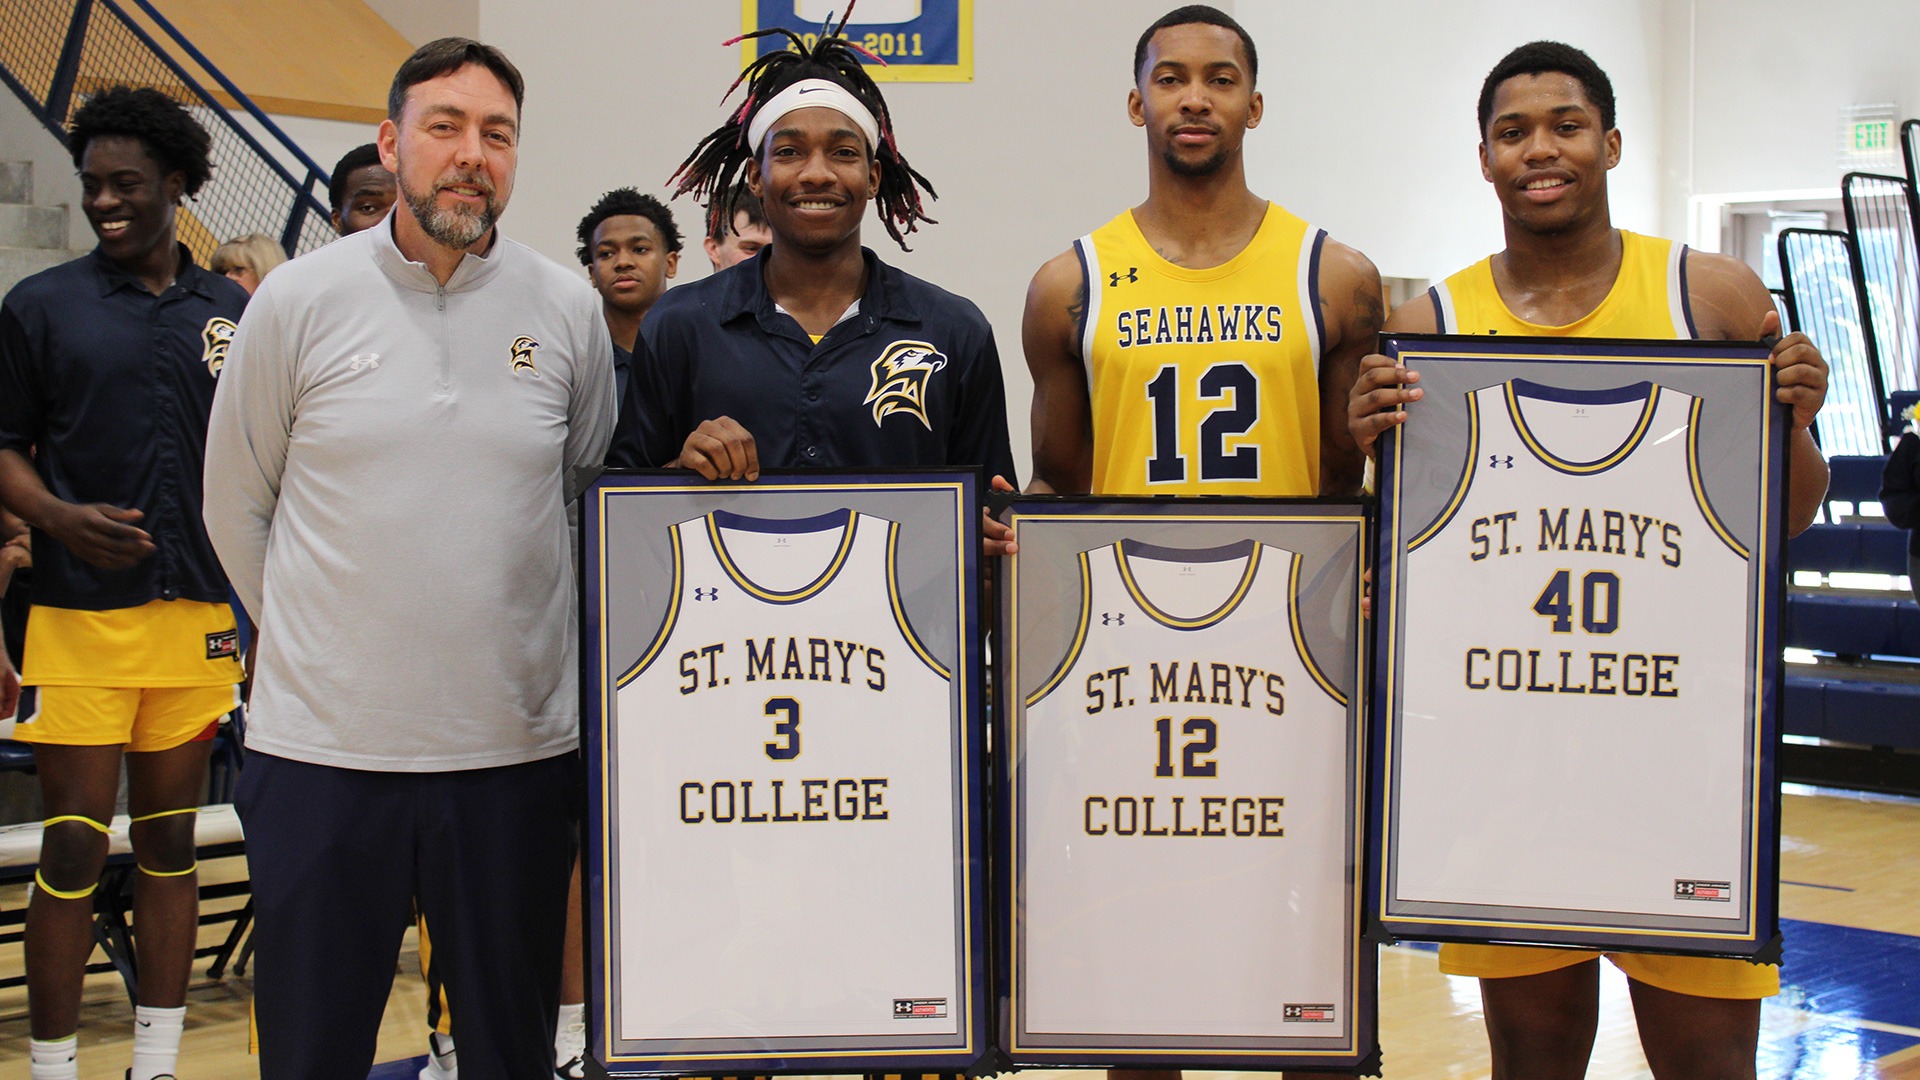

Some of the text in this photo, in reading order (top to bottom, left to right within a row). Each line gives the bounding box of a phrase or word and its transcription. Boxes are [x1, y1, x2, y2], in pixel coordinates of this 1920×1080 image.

[787, 32, 924, 56] 20-2011
[1855, 122, 1888, 149] EXIT
[1117, 304, 1282, 349] SEAHAWKS
[1145, 360, 1261, 486] 12
[1470, 507, 1682, 568] ST. MARY'S
[1530, 568, 1621, 636] 40
[679, 636, 886, 696] ST. MARY'S
[1086, 661, 1285, 716] ST. MARY'S
[1465, 648, 1680, 698] COLLEGE
[763, 695, 803, 762] 3
[1154, 716, 1219, 779] 12
[679, 777, 890, 824] COLLEGE
[1084, 796, 1285, 837] COLLEGE
